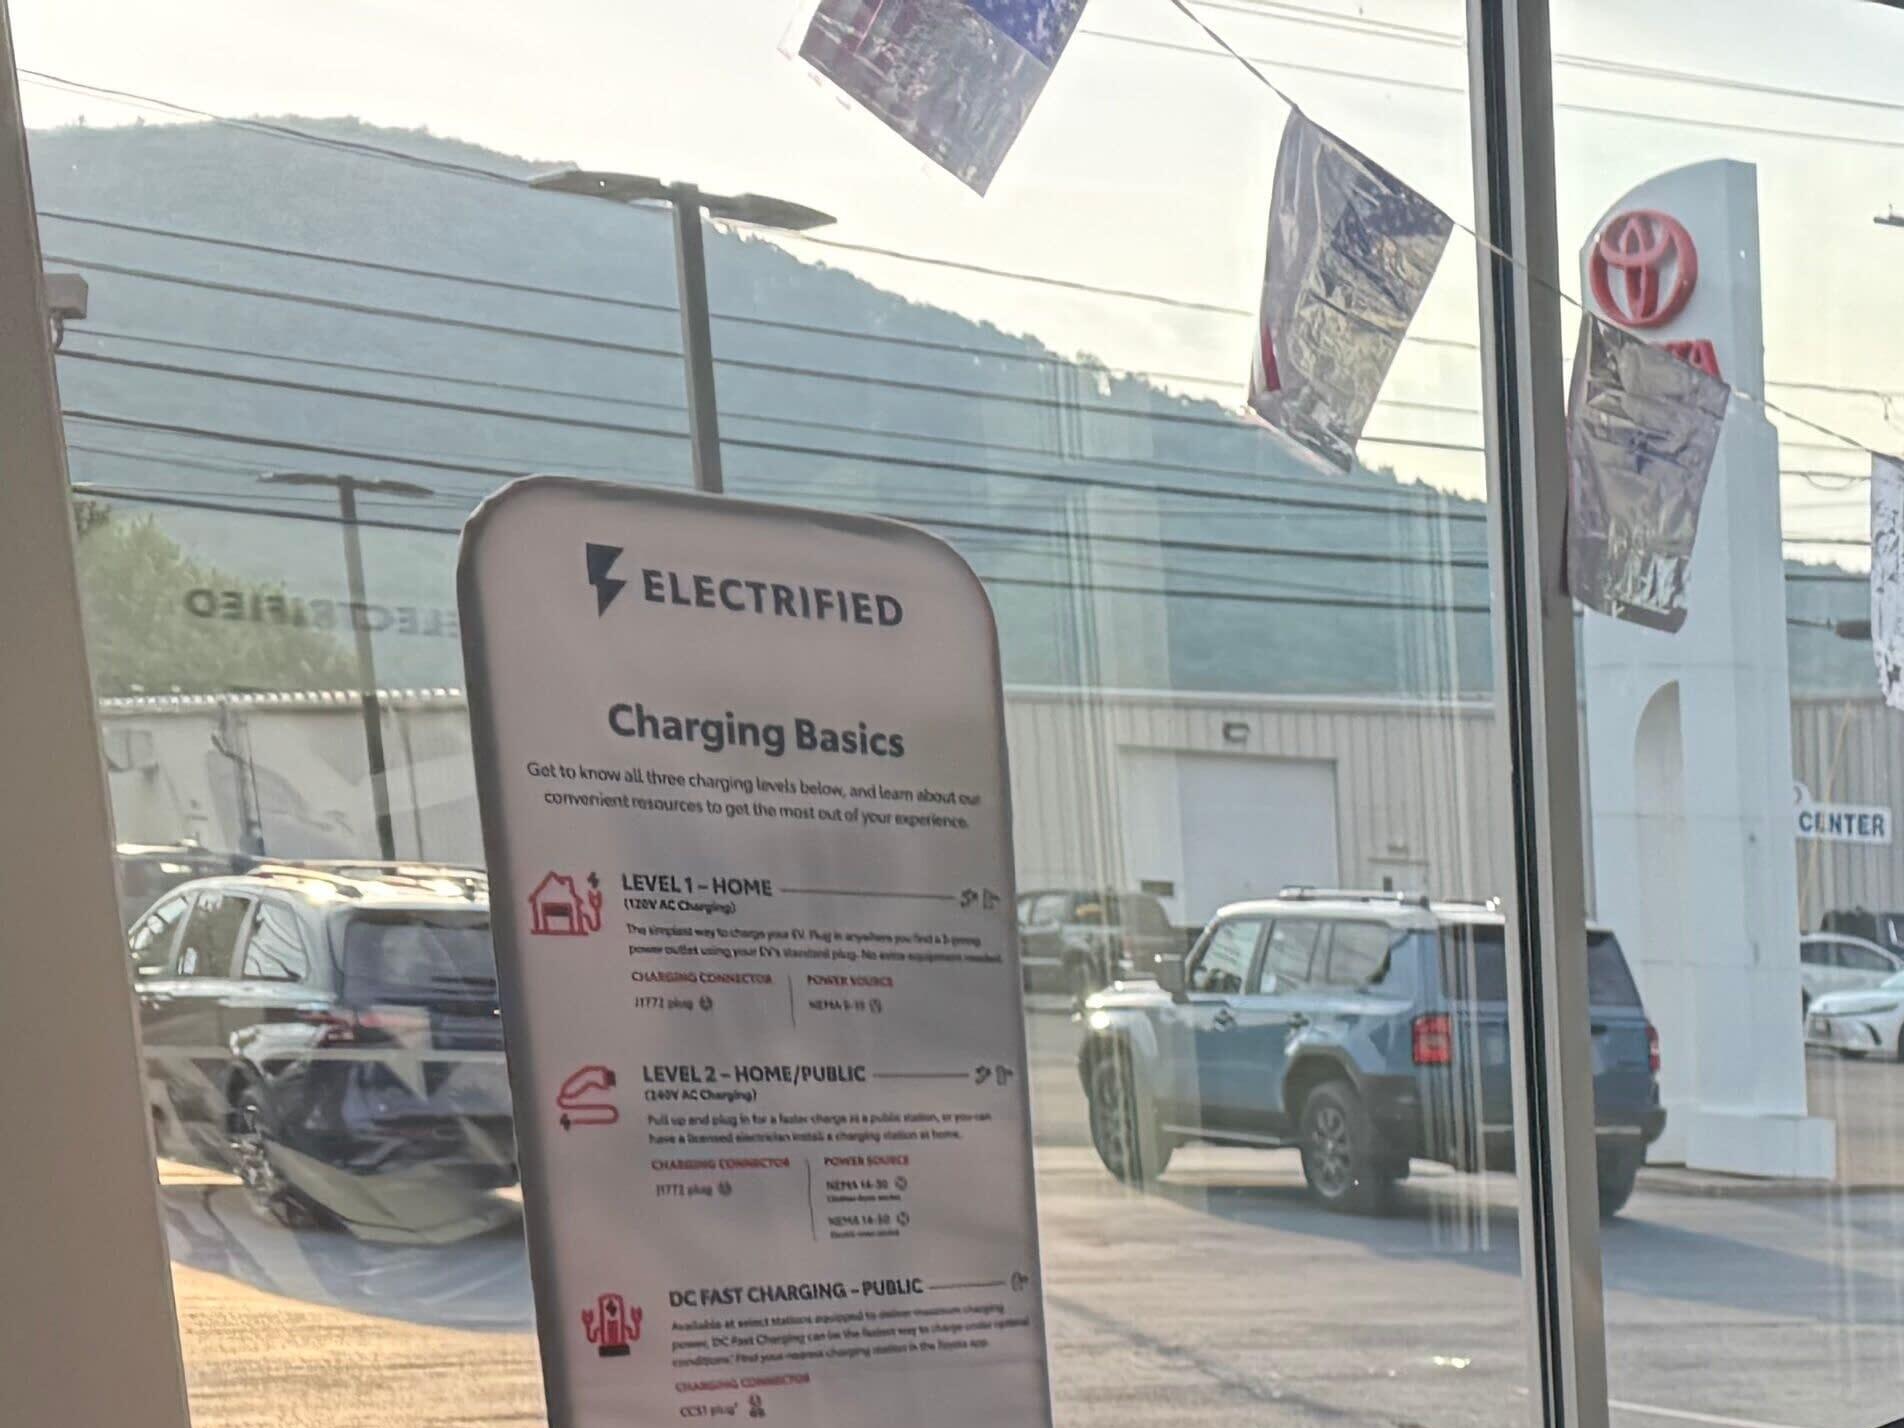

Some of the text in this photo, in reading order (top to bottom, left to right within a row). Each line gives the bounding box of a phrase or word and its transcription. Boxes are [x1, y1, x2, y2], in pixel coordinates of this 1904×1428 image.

[641, 568, 903, 627] ELECTRIFIED
[608, 702, 905, 757] Charging Basics
[527, 761, 557, 778] Get
[560, 764, 576, 779] to
[580, 764, 620, 782] know
[625, 767, 643, 784] all
[646, 768, 685, 786] three
[689, 773, 753, 793] charging
[756, 777, 796, 794] levels
[801, 780, 846, 798] below,
[850, 784, 876, 798] and
[880, 785, 913, 801] learn
[917, 788, 955, 804] about
[545, 791, 629, 808] convenient
[632, 796, 703, 814] resources
[707, 800, 722, 814] to
[726, 803, 748, 818] get
[753, 803, 776, 818] the
[780, 806, 814, 820] most
[819, 808, 841, 822] out
[845, 807, 858, 822] of
[861, 811, 891, 827] your
[622, 873, 773, 896] LEVEL 1 HOME
[660, 899, 676, 912] AC
[643, 1064, 866, 1087] LEVEL 2 HOME/PUBLIC
[669, 1277, 924, 1307] DC FAST CHARGING PUBLIC
